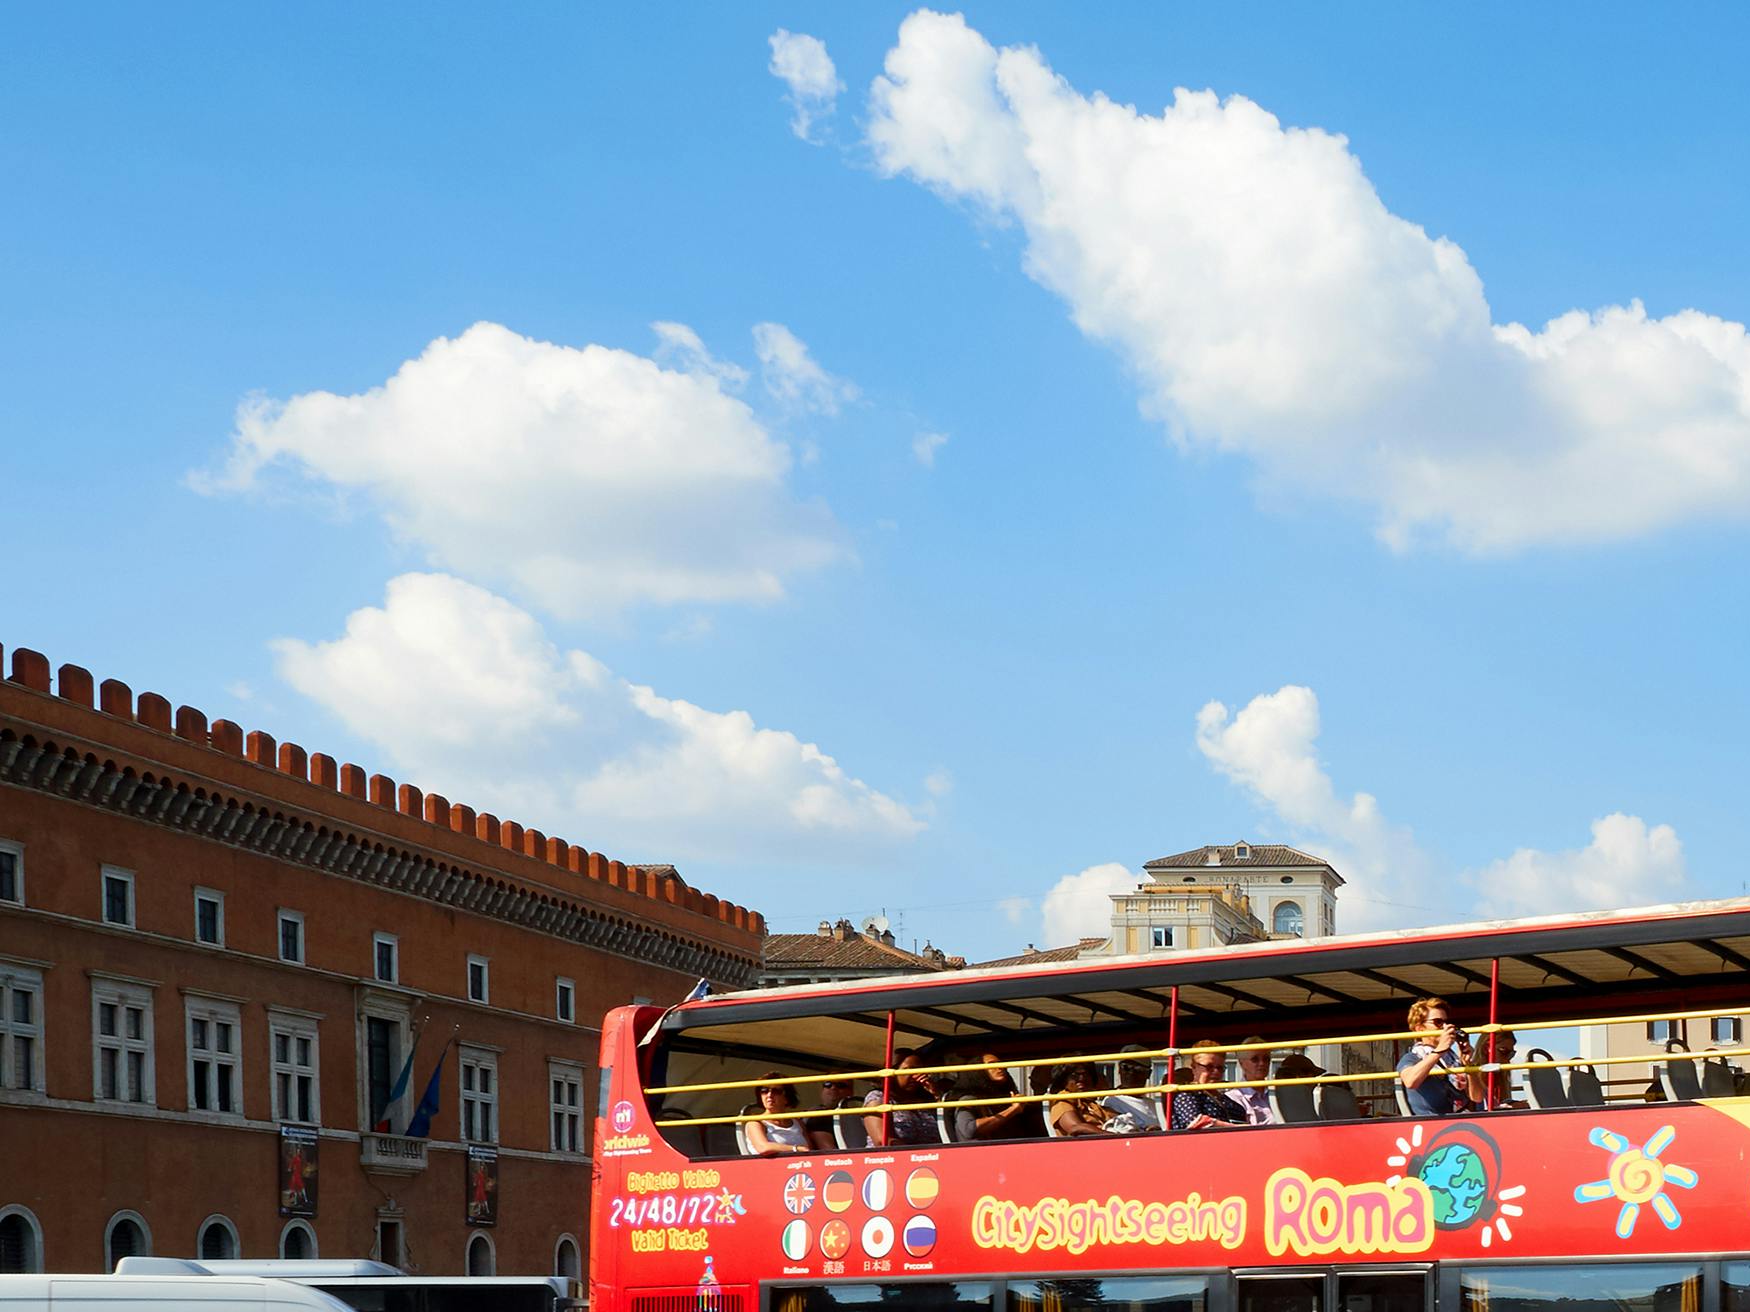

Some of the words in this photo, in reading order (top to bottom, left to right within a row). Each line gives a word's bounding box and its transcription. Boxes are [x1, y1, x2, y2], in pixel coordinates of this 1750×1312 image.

[627, 1172, 680, 1194] Biglietto
[683, 1169, 721, 1189] Valido
[610, 1194, 715, 1227] 24/48/72
[1263, 1167, 1435, 1257] Roma
[631, 1229, 665, 1252] Valid
[667, 1228, 709, 1251] Ticket
